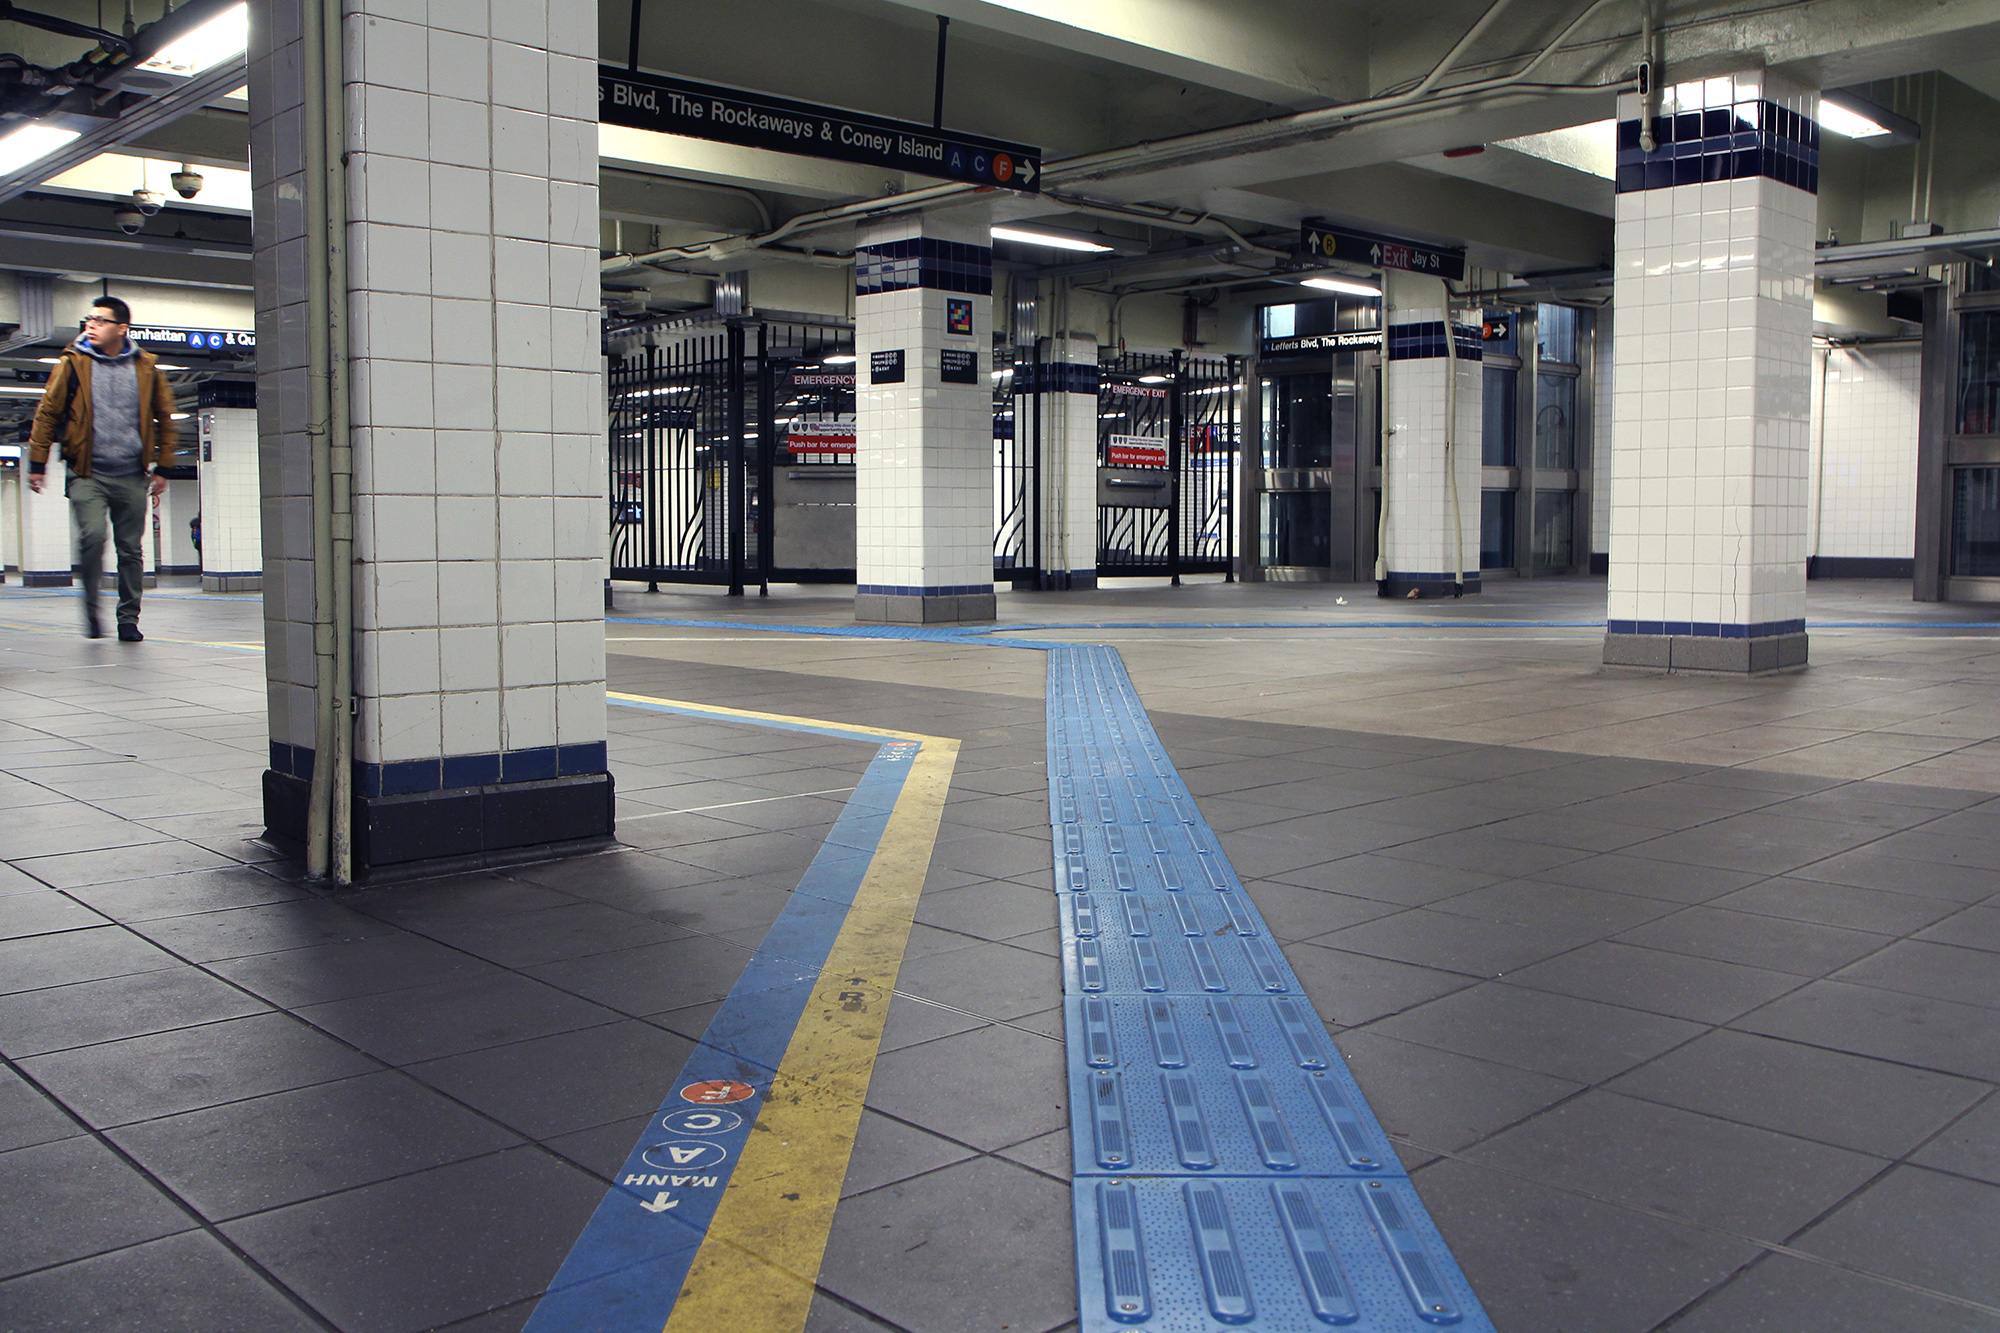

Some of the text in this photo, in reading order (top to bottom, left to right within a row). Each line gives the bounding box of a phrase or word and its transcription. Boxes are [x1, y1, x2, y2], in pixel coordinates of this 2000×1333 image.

[613, 83, 661, 115] Blvd,
[668, 93, 704, 118] The
[711, 100, 814, 139] Rockaways
[820, 121, 833, 141] &
[840, 124, 893, 155] Coney
[898, 135, 944, 161] Island
[950, 151, 961, 168] A
[974, 155, 985, 172] C
[1383, 244, 1440, 269] Exit Jay St
[127, 328, 187, 342] anhattan
[192, 335, 202, 345] A
[210, 336, 220, 346] C
[225, 332, 236, 345] &
[1271, 341, 1298, 351] Lefferts
[1300, 338, 1319, 350] Blvd,
[1321, 336, 1336, 347] The
[794, 375, 856, 385] EMERGENCY
[1113, 385, 1166, 398] EMERGENCY EXIT
[700, 1085, 731, 1101] F
[683, 1113, 722, 1129] C
[668, 1146, 707, 1164] A
[623, 1173, 719, 1188] MANH
